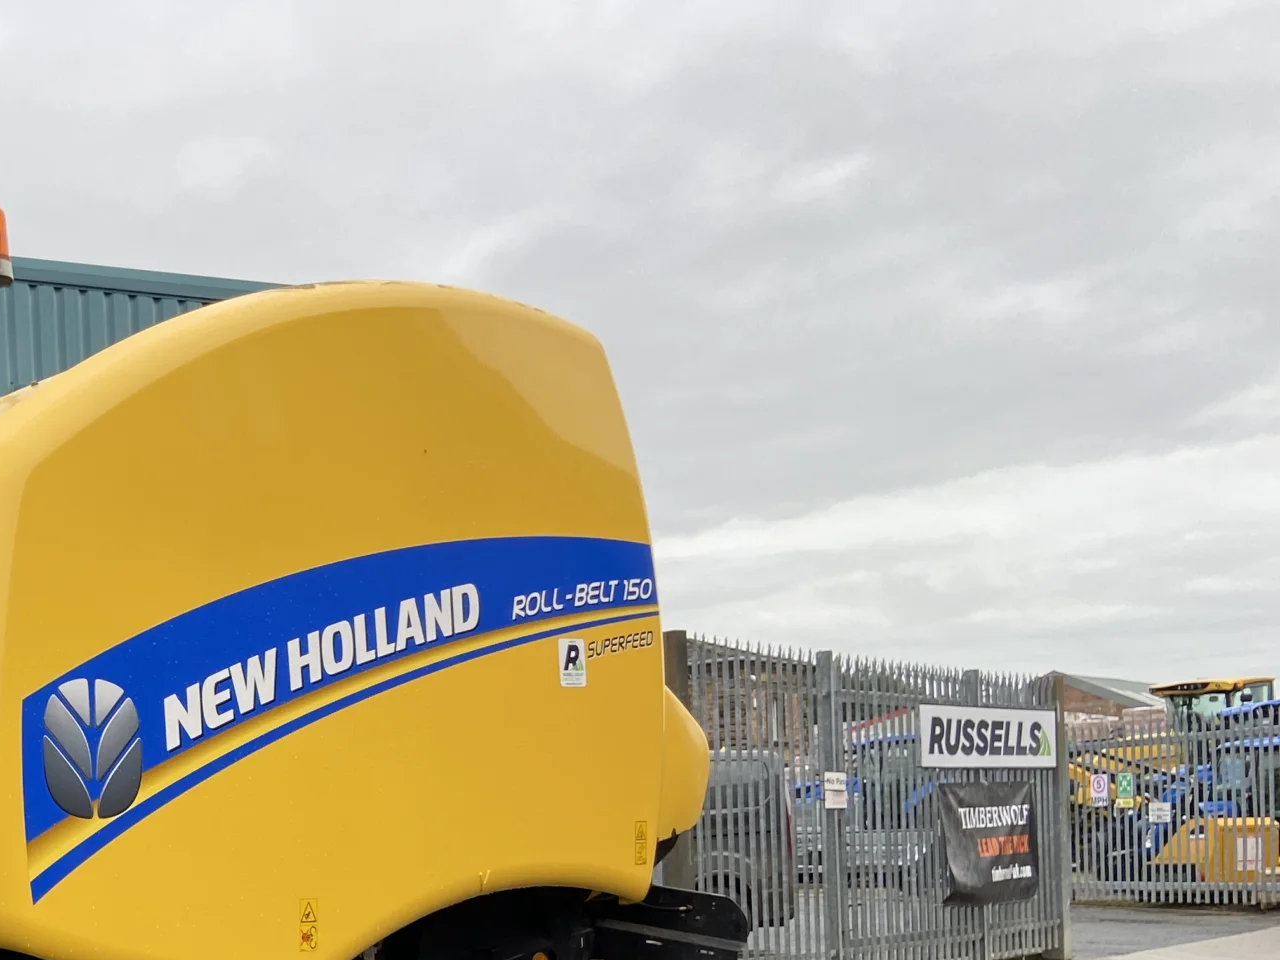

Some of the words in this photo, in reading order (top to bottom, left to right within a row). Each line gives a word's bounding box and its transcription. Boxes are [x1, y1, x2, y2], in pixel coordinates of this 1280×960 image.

[512, 579, 618, 620] ROLL-BELT
[623, 578, 652, 601] 150
[587, 631, 653, 658] SUPERFEED
[164, 647, 277, 752] NEW
[287, 583, 480, 692] HOLLAND
[928, 716, 1042, 756] RUSSELLS
[958, 804, 1030, 829] TIMBERWOLF
